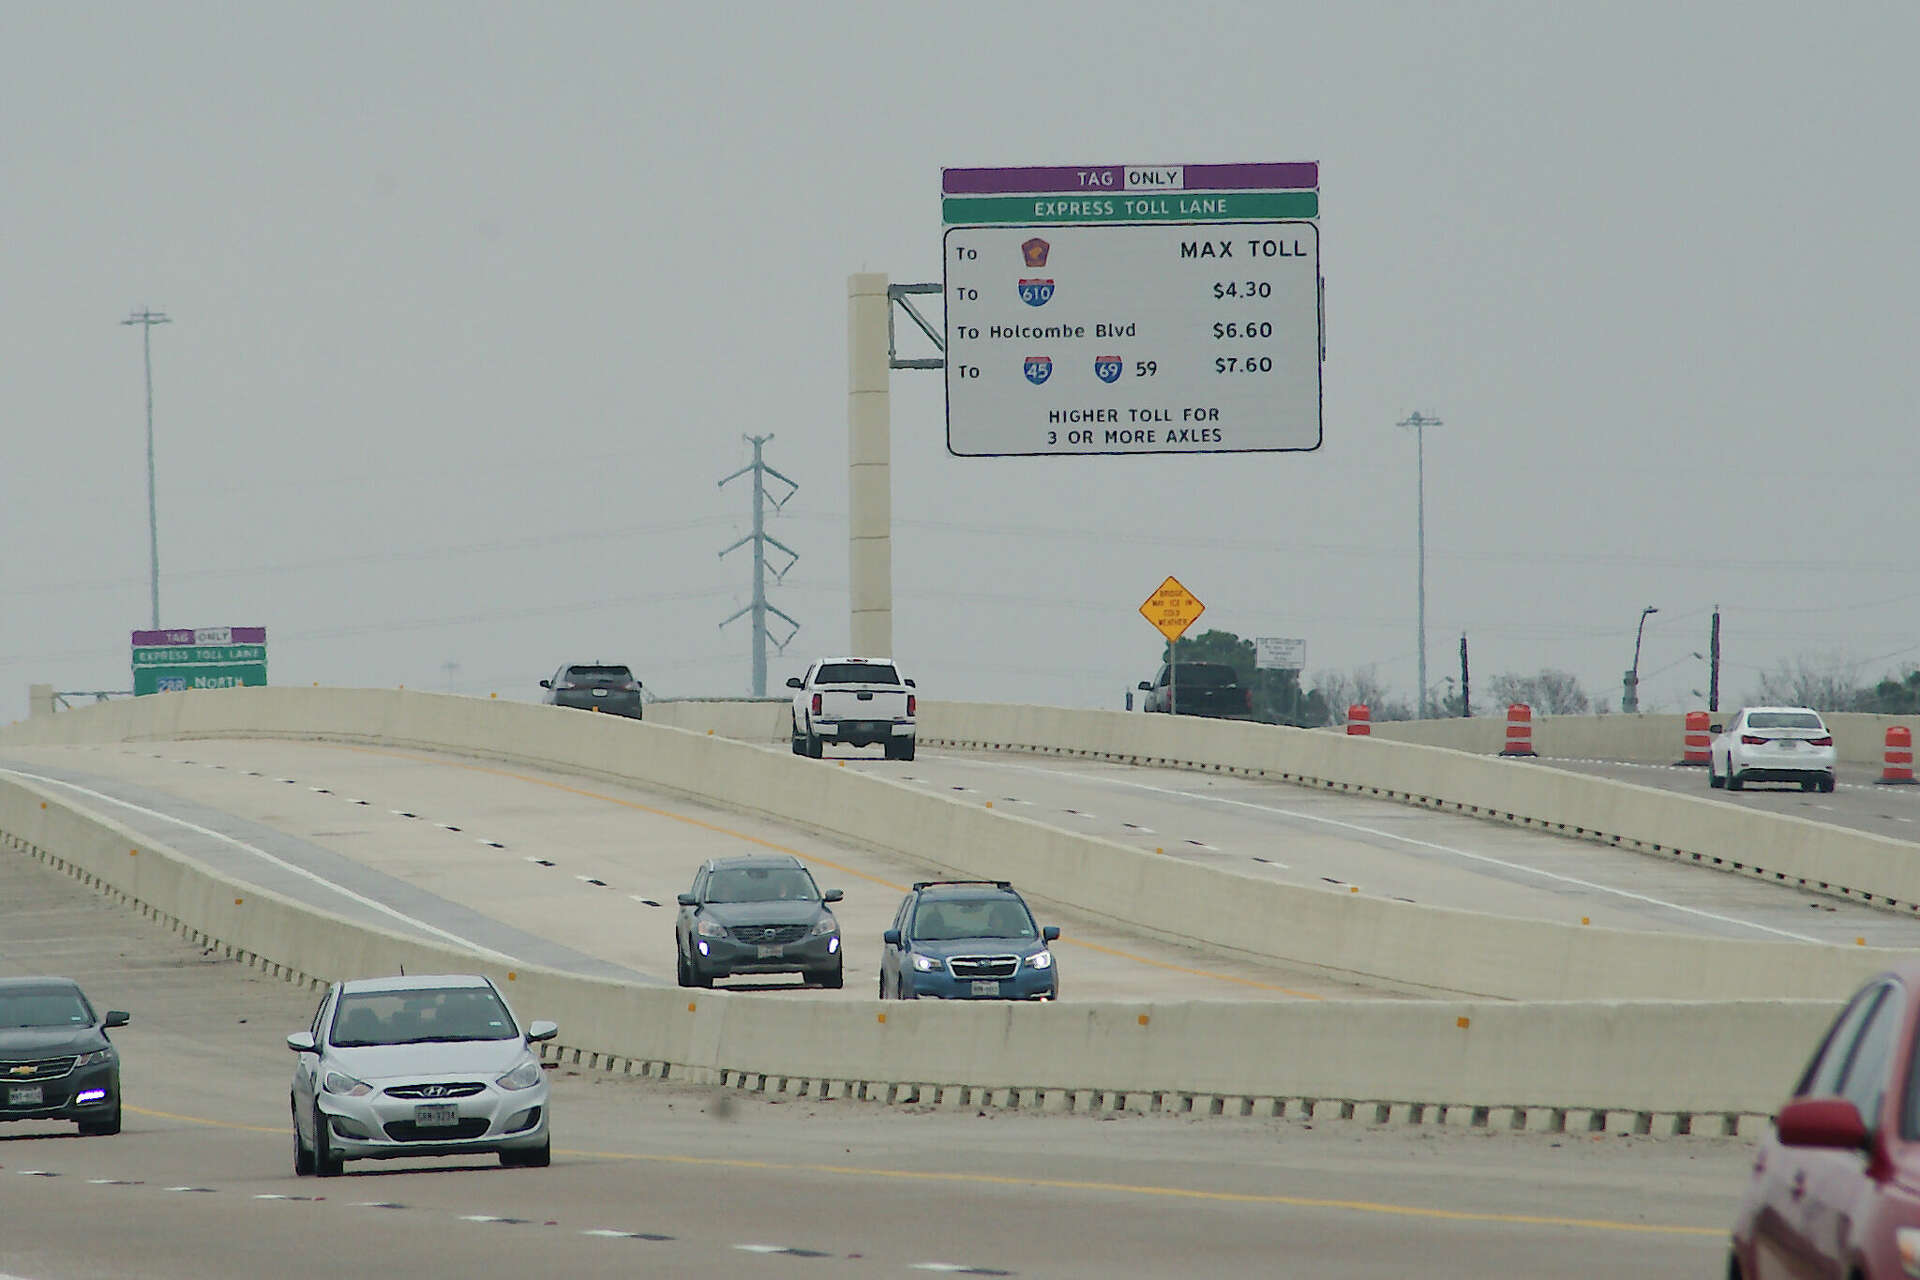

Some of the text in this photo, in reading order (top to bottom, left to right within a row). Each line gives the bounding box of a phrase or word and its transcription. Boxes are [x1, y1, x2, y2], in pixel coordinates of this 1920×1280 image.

[1077, 170, 1178, 187] TAG ONLY
[1034, 199, 1229, 217] EXPRESS TOLL LANE
[956, 247, 978, 261] To
[1180, 239, 1308, 259] MAX TOLL
[957, 286, 1051, 302] To 610
[1213, 281, 1272, 300] $4.30
[957, 323, 1137, 340] To Holcombe Blvd
[1212, 321, 1274, 340] $6.60
[958, 361, 1158, 379] To 45 69 59
[1214, 356, 1274, 375] $7.60
[1048, 407, 1221, 424] HIGHER TOLL FOR
[1047, 428, 1223, 445] 3 OR MORE AXLES
[166, 631, 229, 642] TAG ONLY
[139, 649, 259, 662] EXPRESS TOLL LANE
